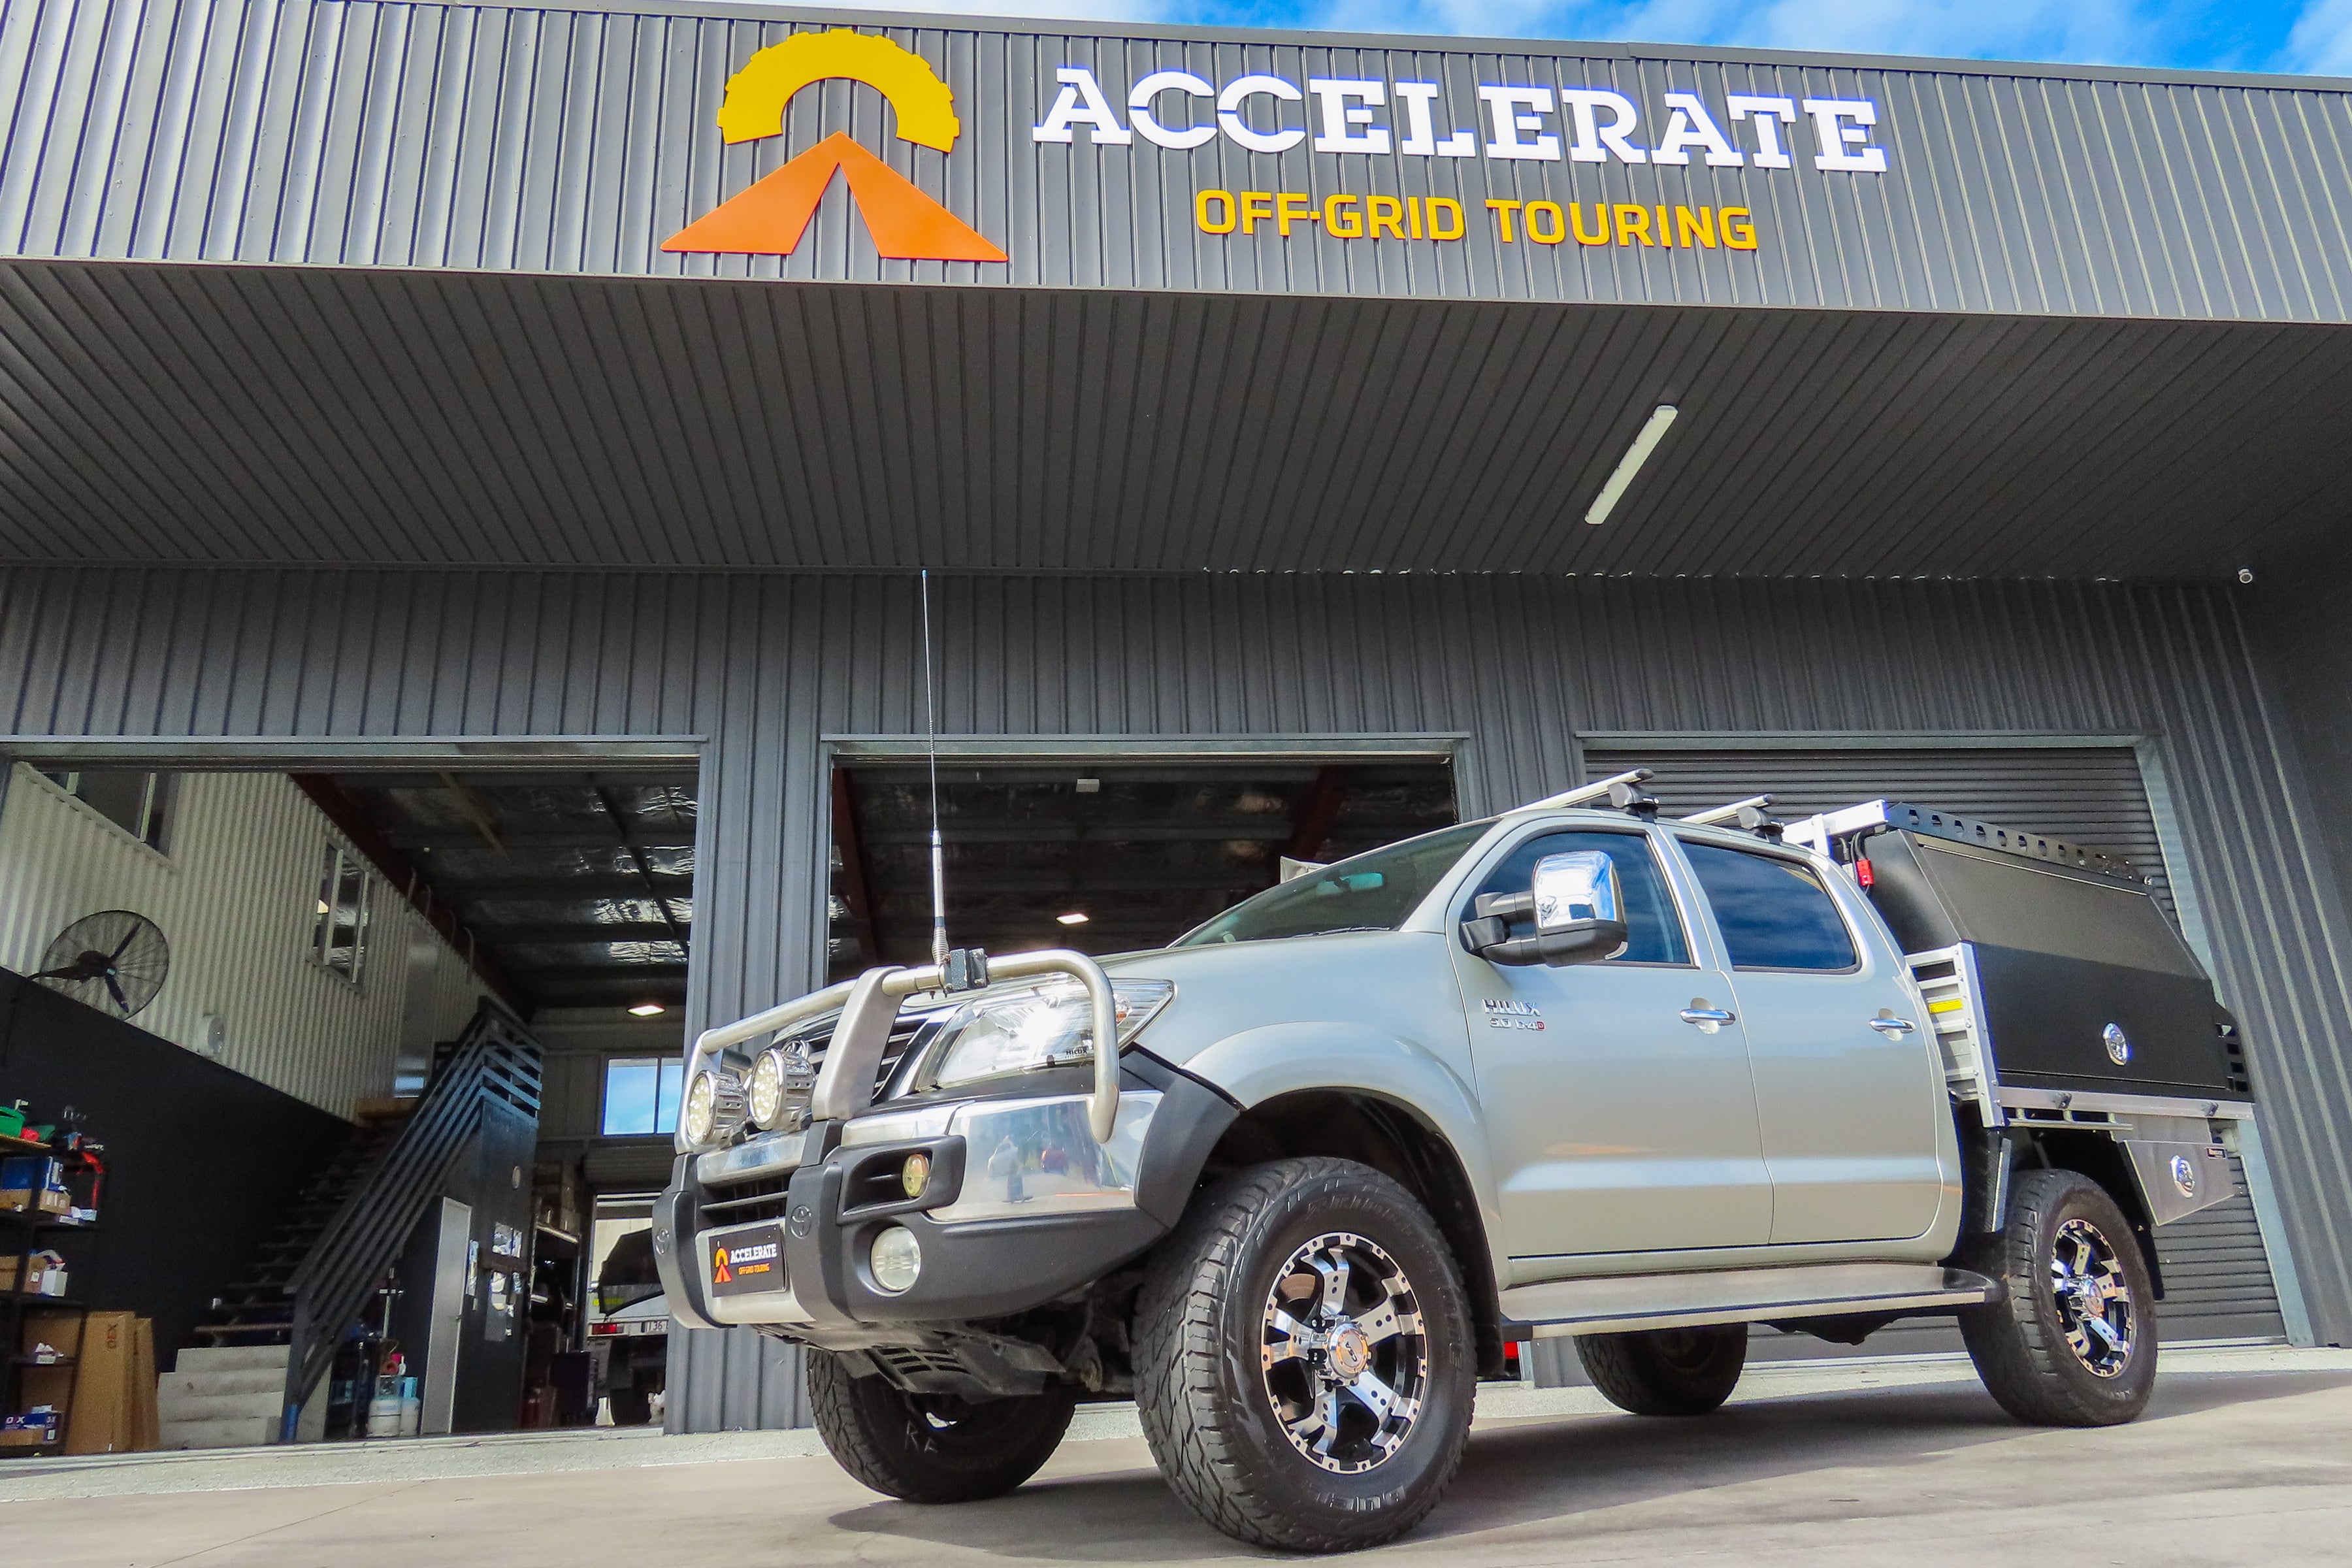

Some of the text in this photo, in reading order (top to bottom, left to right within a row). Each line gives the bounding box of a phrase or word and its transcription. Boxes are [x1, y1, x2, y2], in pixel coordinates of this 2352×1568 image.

[1032, 67, 1887, 172] ACCELERATE
[1195, 189, 1758, 250] OFF-GRID TOURING
[1482, 999, 1541, 1016] HILUX
[1066, 1046, 1088, 1055] HILUX
[730, 1243, 777, 1264] ACCELERATE
